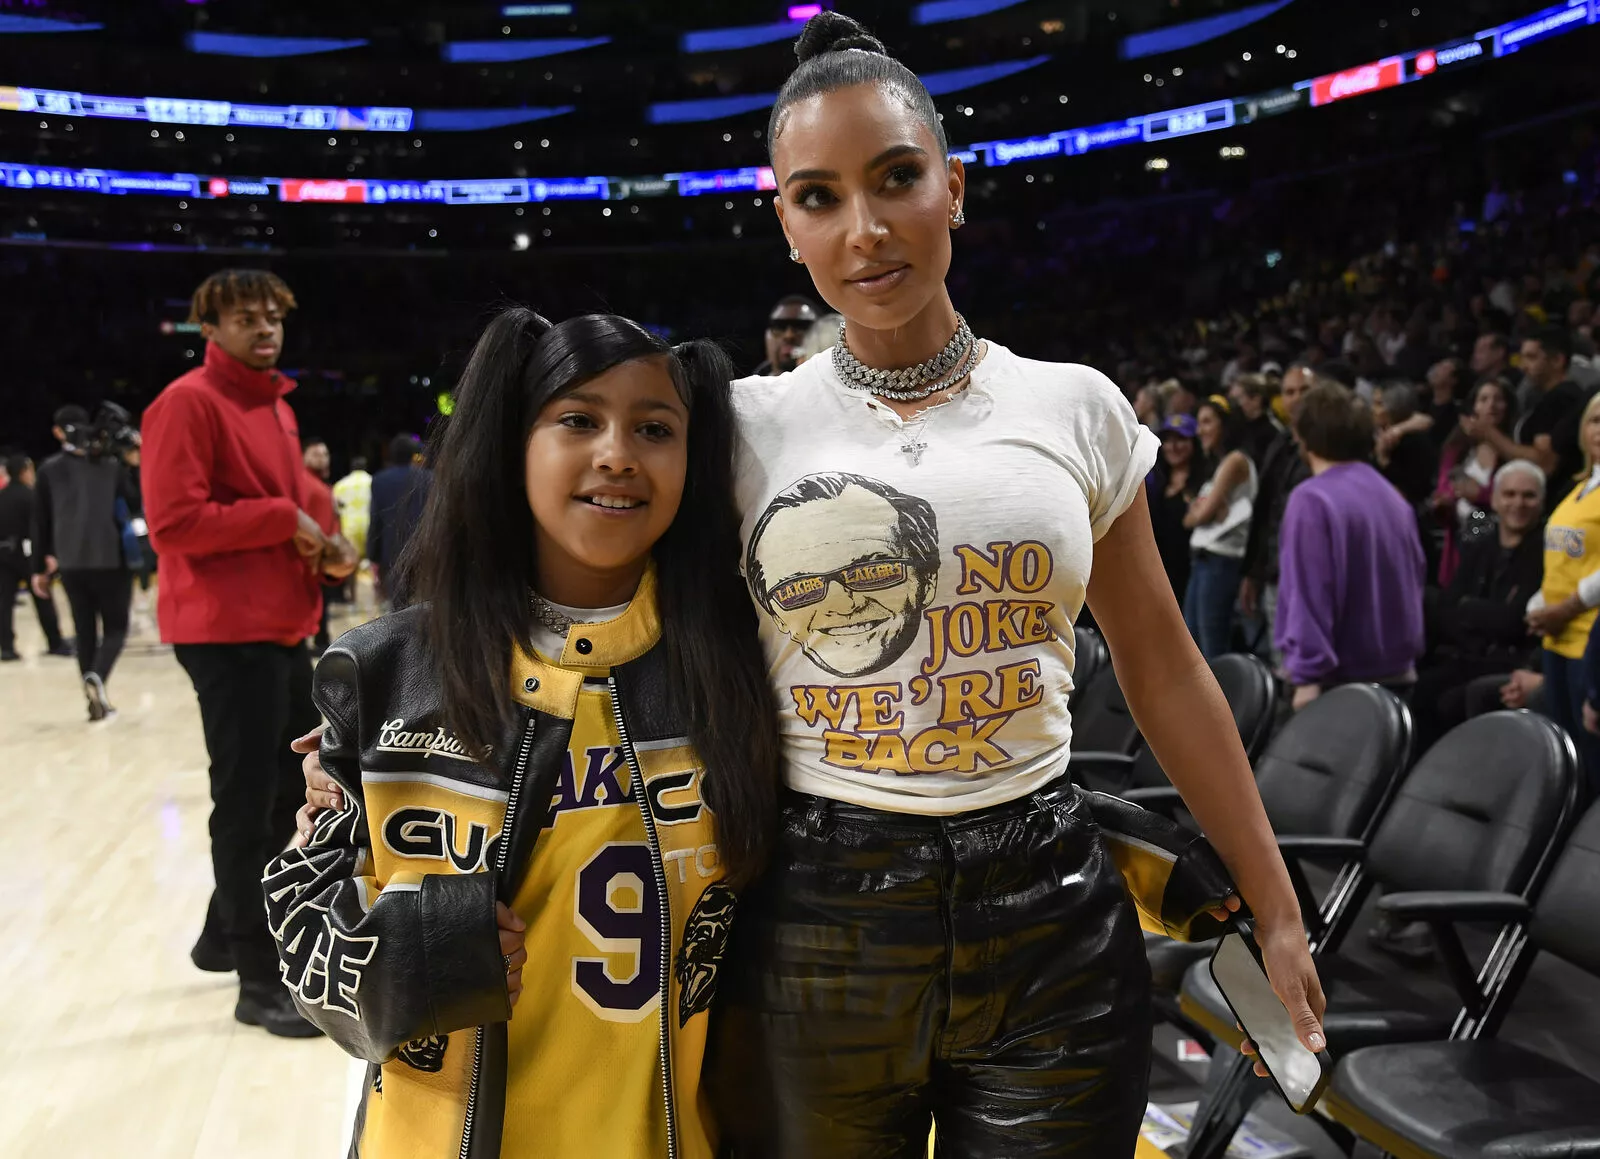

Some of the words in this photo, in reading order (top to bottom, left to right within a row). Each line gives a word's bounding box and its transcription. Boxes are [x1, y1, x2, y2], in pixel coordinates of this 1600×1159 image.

[776, 576, 825, 602] LAKERS
[841, 562, 902, 584] LAKERS
[953, 539, 1053, 596] NO
[790, 657, 1044, 733] WE'RE
[819, 711, 1014, 776] BACK
[571, 840, 661, 1024] 9
